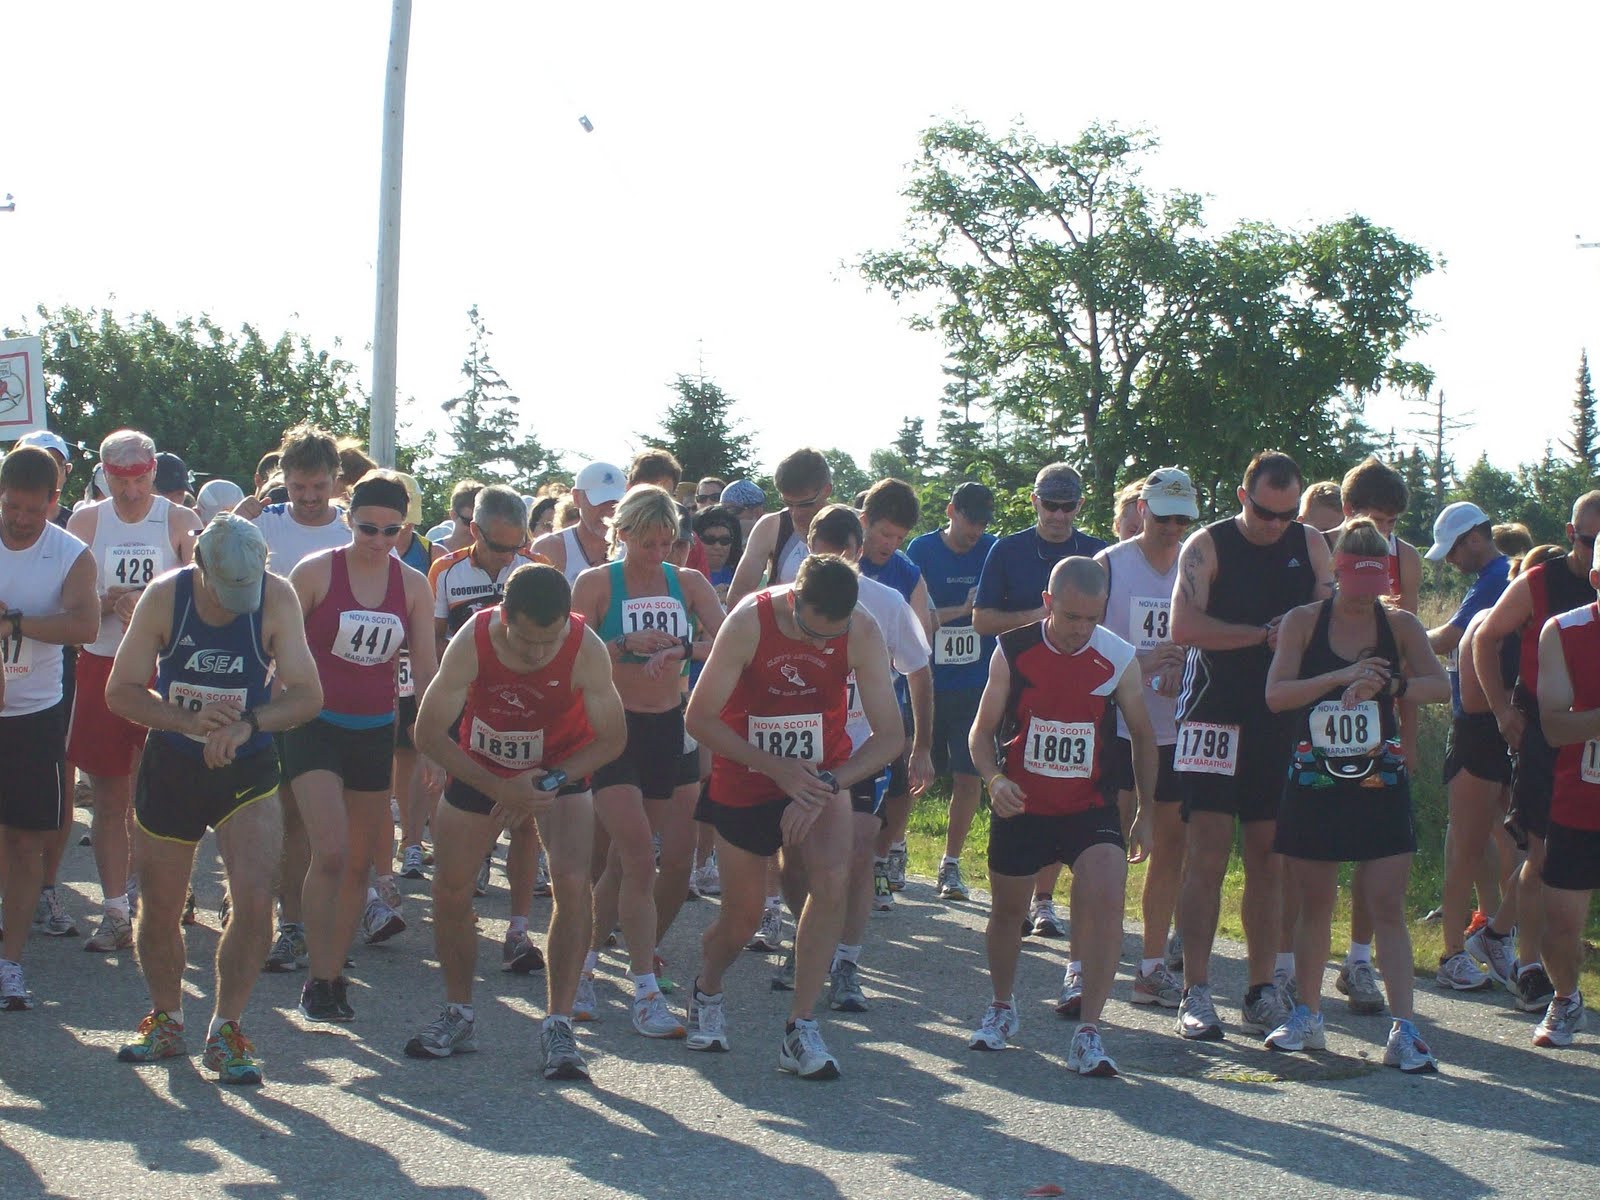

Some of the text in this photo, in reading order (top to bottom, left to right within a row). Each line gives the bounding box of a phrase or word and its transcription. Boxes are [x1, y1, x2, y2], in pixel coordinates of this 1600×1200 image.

[115, 557, 153, 584] 428
[450, 584, 493, 597] GOODWINS
[627, 601, 682, 610] NOVA SCOTIA
[349, 614, 398, 625] NOVA SCOTIA
[628, 611, 678, 637] 1881
[350, 624, 393, 655] 441
[944, 635, 974, 657] 400
[184, 648, 244, 674] ASEA
[175, 686, 242, 702] NOVA SCOTIA
[1318, 704, 1340, 712] NOVA
[476, 725, 500, 740] NOVA
[753, 720, 818, 730] NOVA SCOTIA
[1034, 723, 1091, 736] NOVA SCOTIA
[1325, 714, 1368, 744] 408
[477, 731, 531, 760] 1831
[754, 730, 813, 760] 1823
[1033, 733, 1086, 765] 1803
[1182, 730, 1230, 760] 1798
[1325, 746, 1367, 754] MARATHON
[1028, 761, 1089, 773] HALF MARATHON
[1193, 760, 1232, 769] MARATHON
